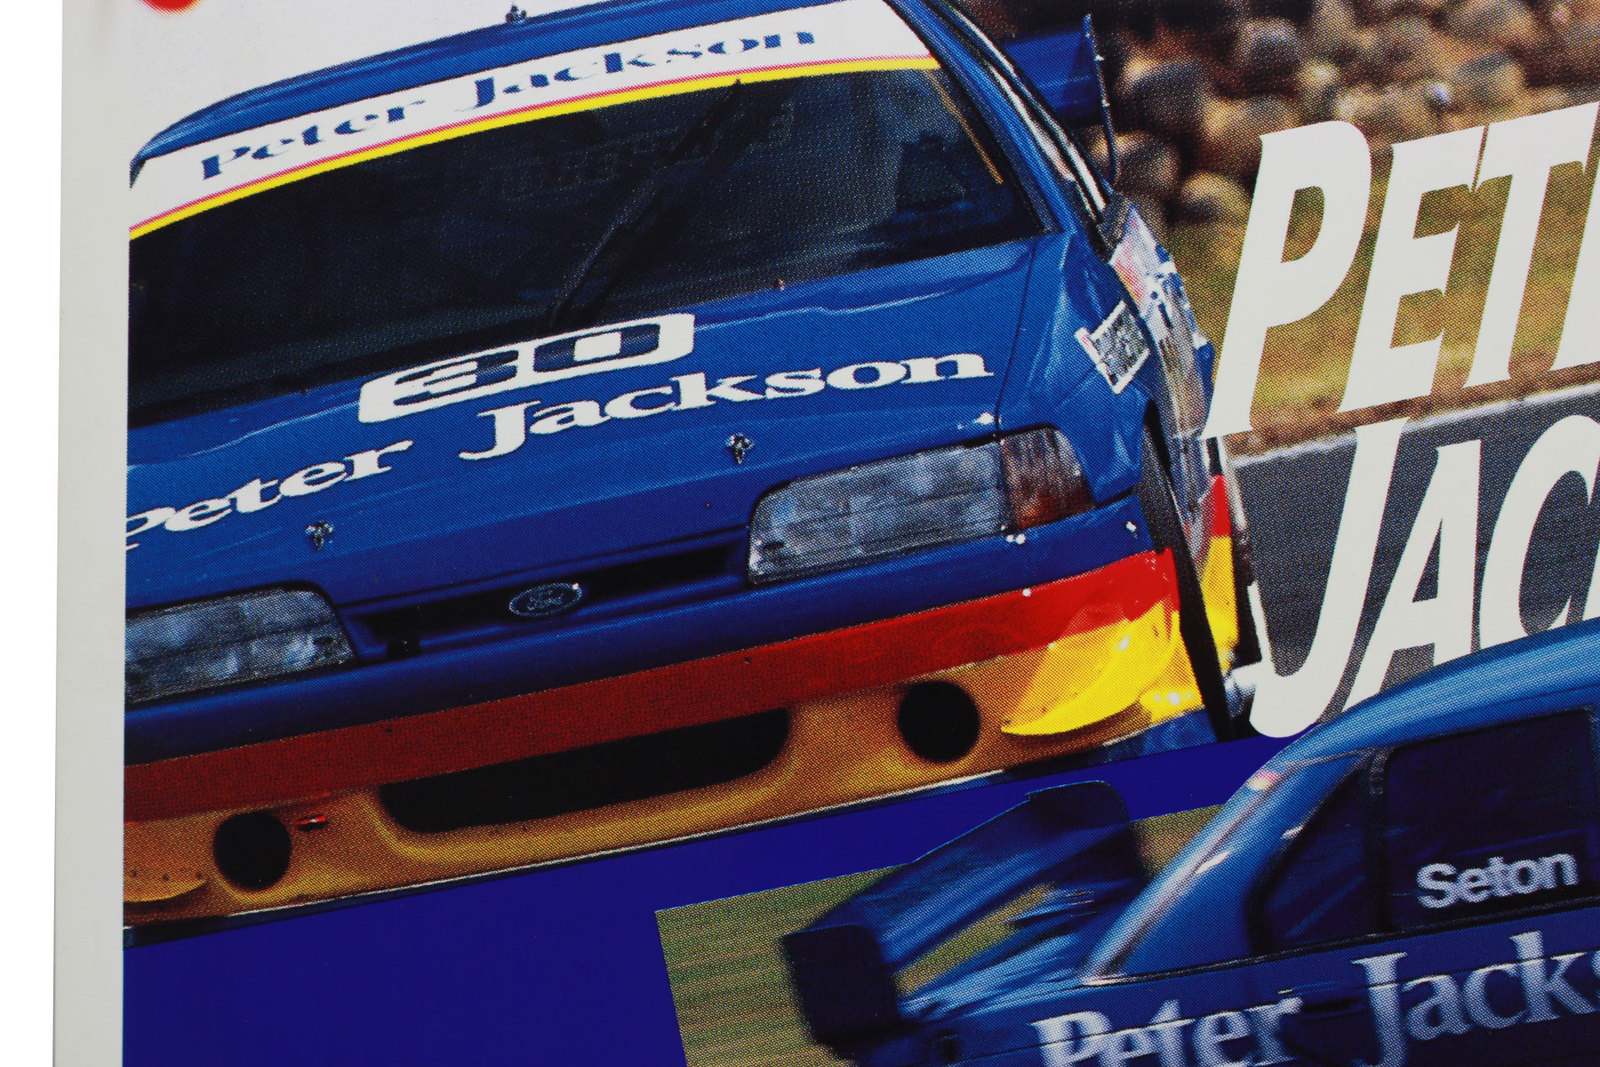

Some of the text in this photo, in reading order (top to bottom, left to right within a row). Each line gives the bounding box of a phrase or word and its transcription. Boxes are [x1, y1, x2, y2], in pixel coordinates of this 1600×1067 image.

[200, 99, 427, 181] Peter
[453, 31, 816, 113] Jackson
[458, 352, 995, 461] Jackson
[1248, 414, 1600, 739] JAC
[1416, 850, 1579, 910] Seton
[1026, 930, 1600, 1067] Peter Jack
